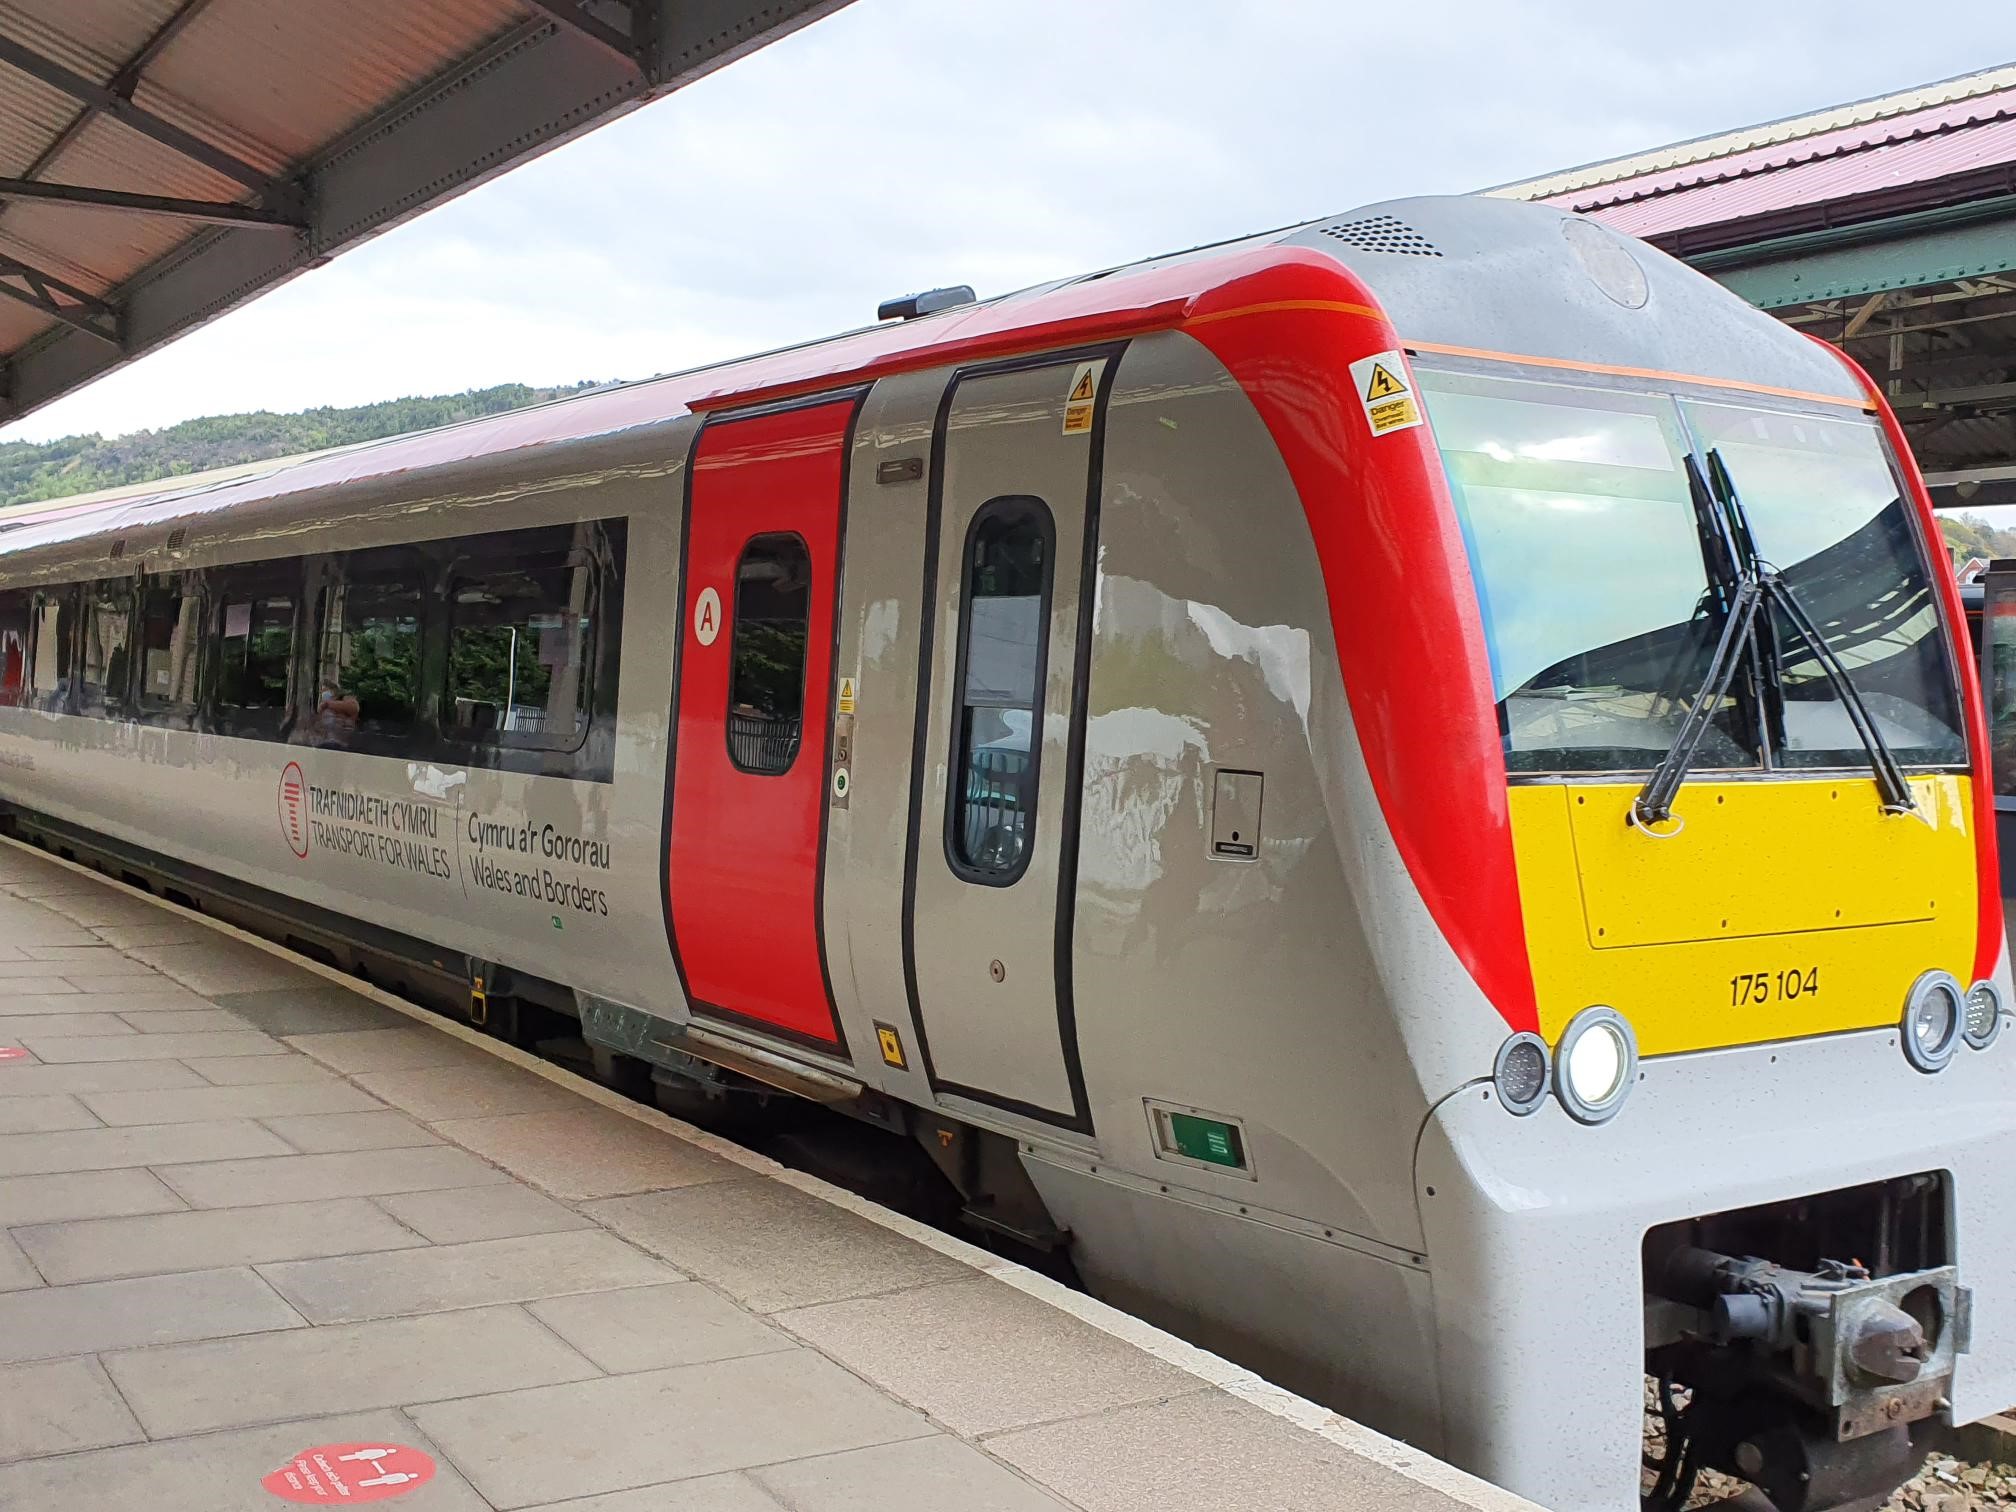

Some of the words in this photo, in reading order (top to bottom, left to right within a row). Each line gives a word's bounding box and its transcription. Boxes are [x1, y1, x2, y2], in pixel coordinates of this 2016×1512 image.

[1371, 401, 1405, 416] Danger
[700, 601, 713, 631] A
[309, 786, 389, 829] TRAFNIDIAETH
[391, 804, 438, 839] CYMRU
[311, 821, 377, 861] TRANSPORT
[378, 837, 405, 868] FOR
[405, 843, 451, 880] WALES
[468, 812, 516, 853] Cymru
[519, 821, 538, 853] a'r
[541, 824, 611, 870] Gororau
[469, 854, 513, 893] Wales
[514, 867, 542, 901] and
[544, 869, 608, 917] Borders
[1730, 972, 1769, 1007] 175
[1776, 966, 1818, 1001] 104
